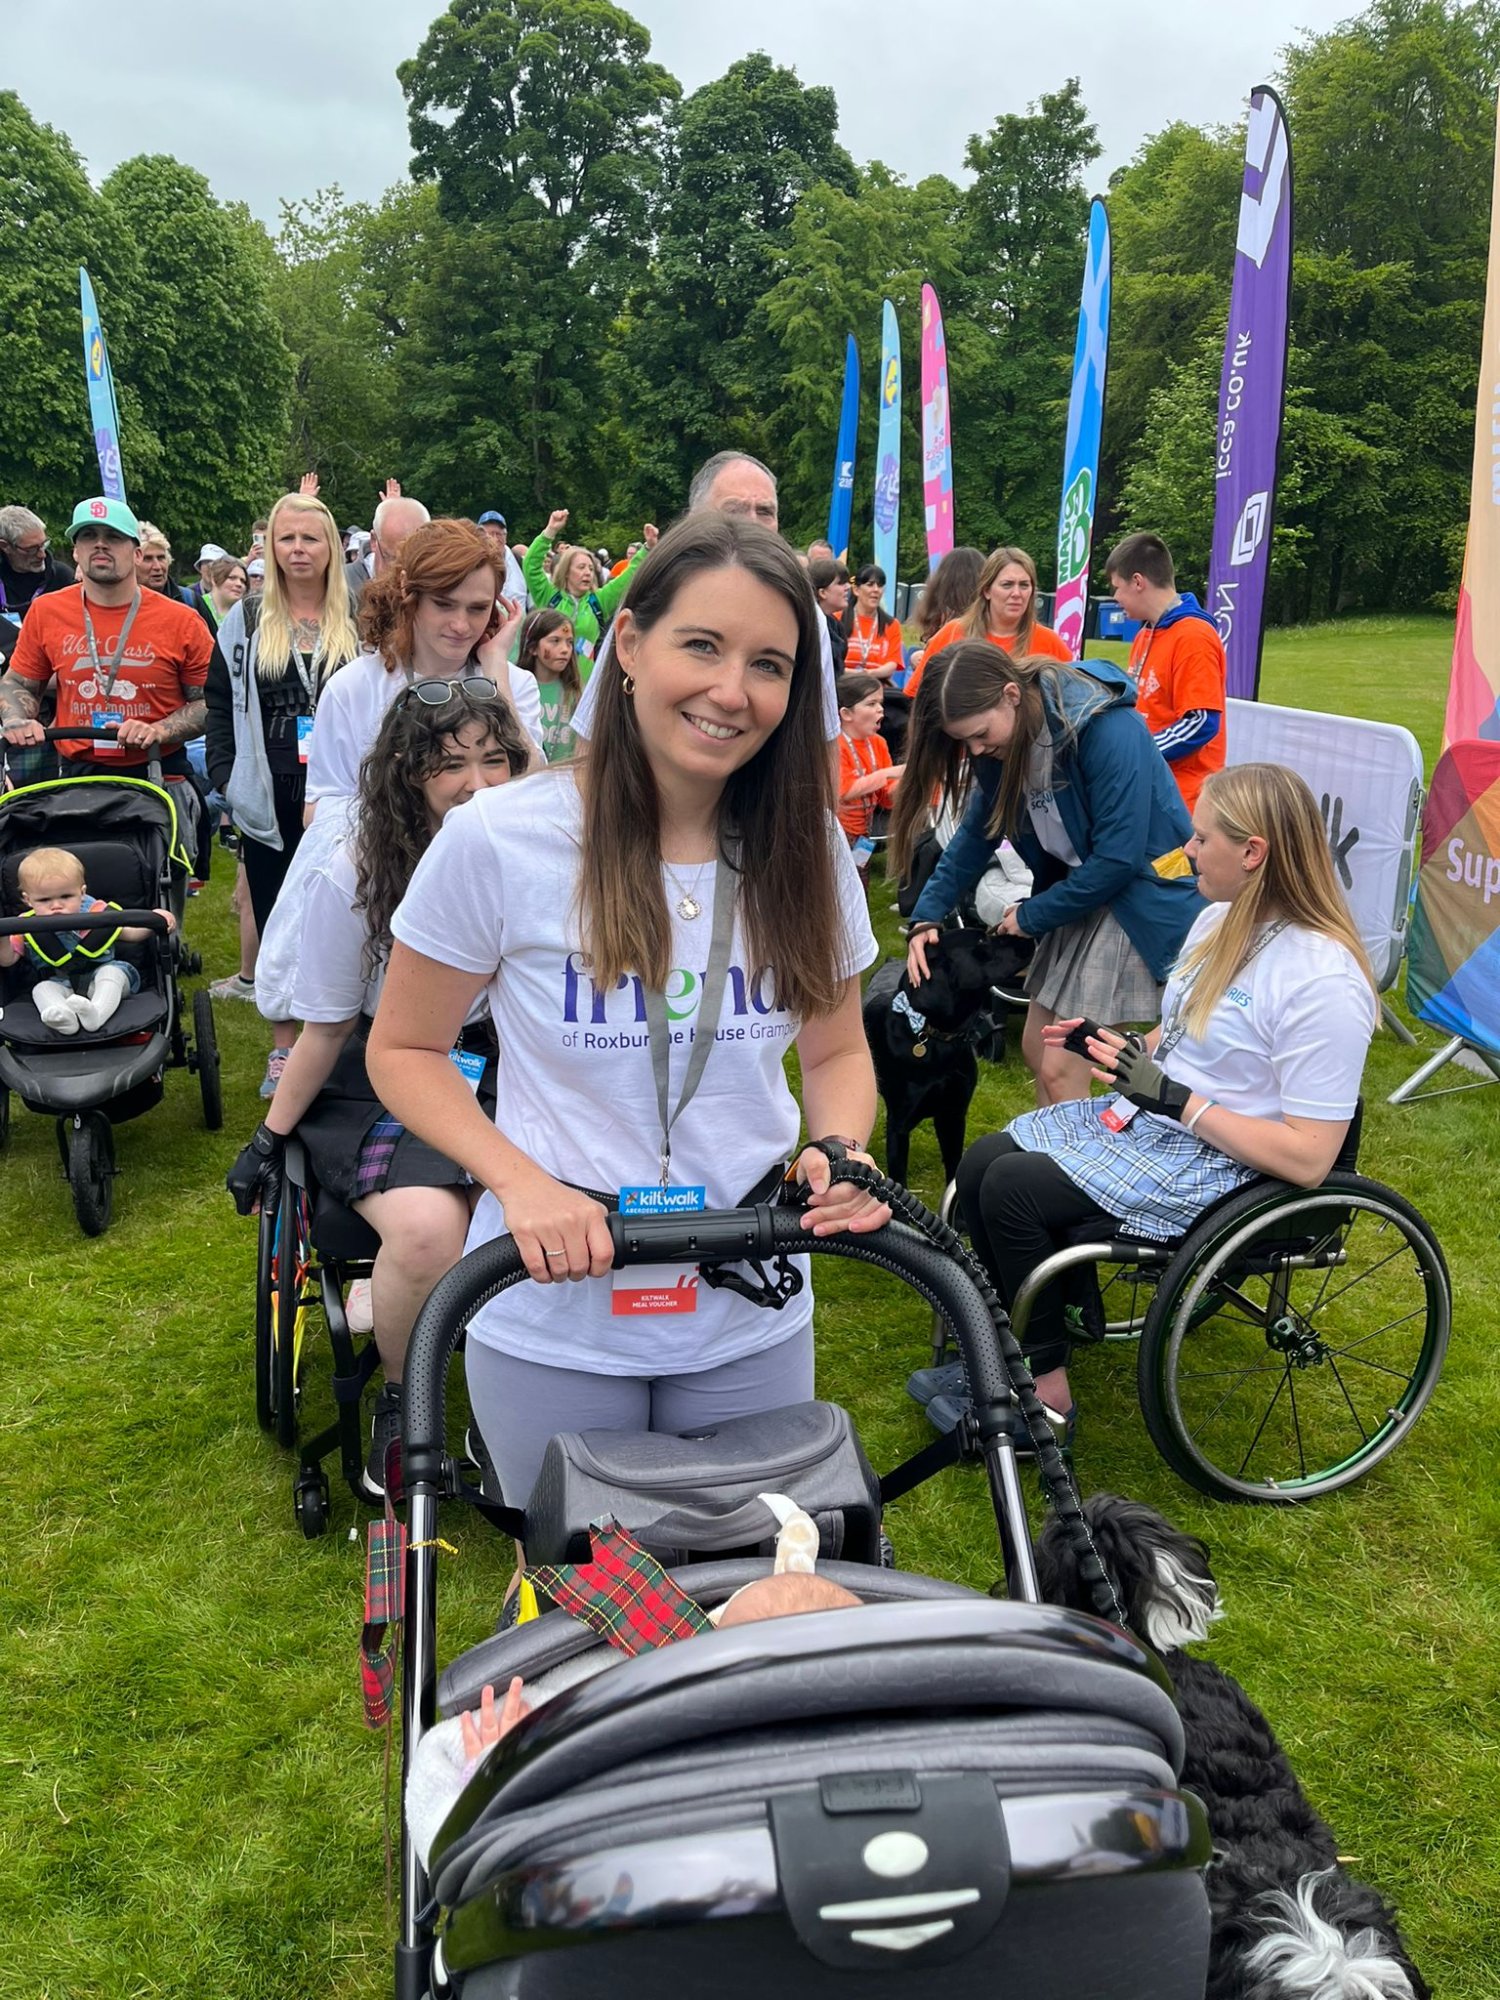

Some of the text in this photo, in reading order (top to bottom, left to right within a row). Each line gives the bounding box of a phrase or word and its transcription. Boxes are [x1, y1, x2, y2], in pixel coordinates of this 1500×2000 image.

[62, 634, 155, 658] We Cast
[1225, 986, 1253, 1008] RIES
[562, 1031, 579, 1047] of
[584, 1031, 684, 1049] Roxbure
[690, 1027, 745, 1044] Huse
[640, 1189, 699, 1206] kiltwalk
